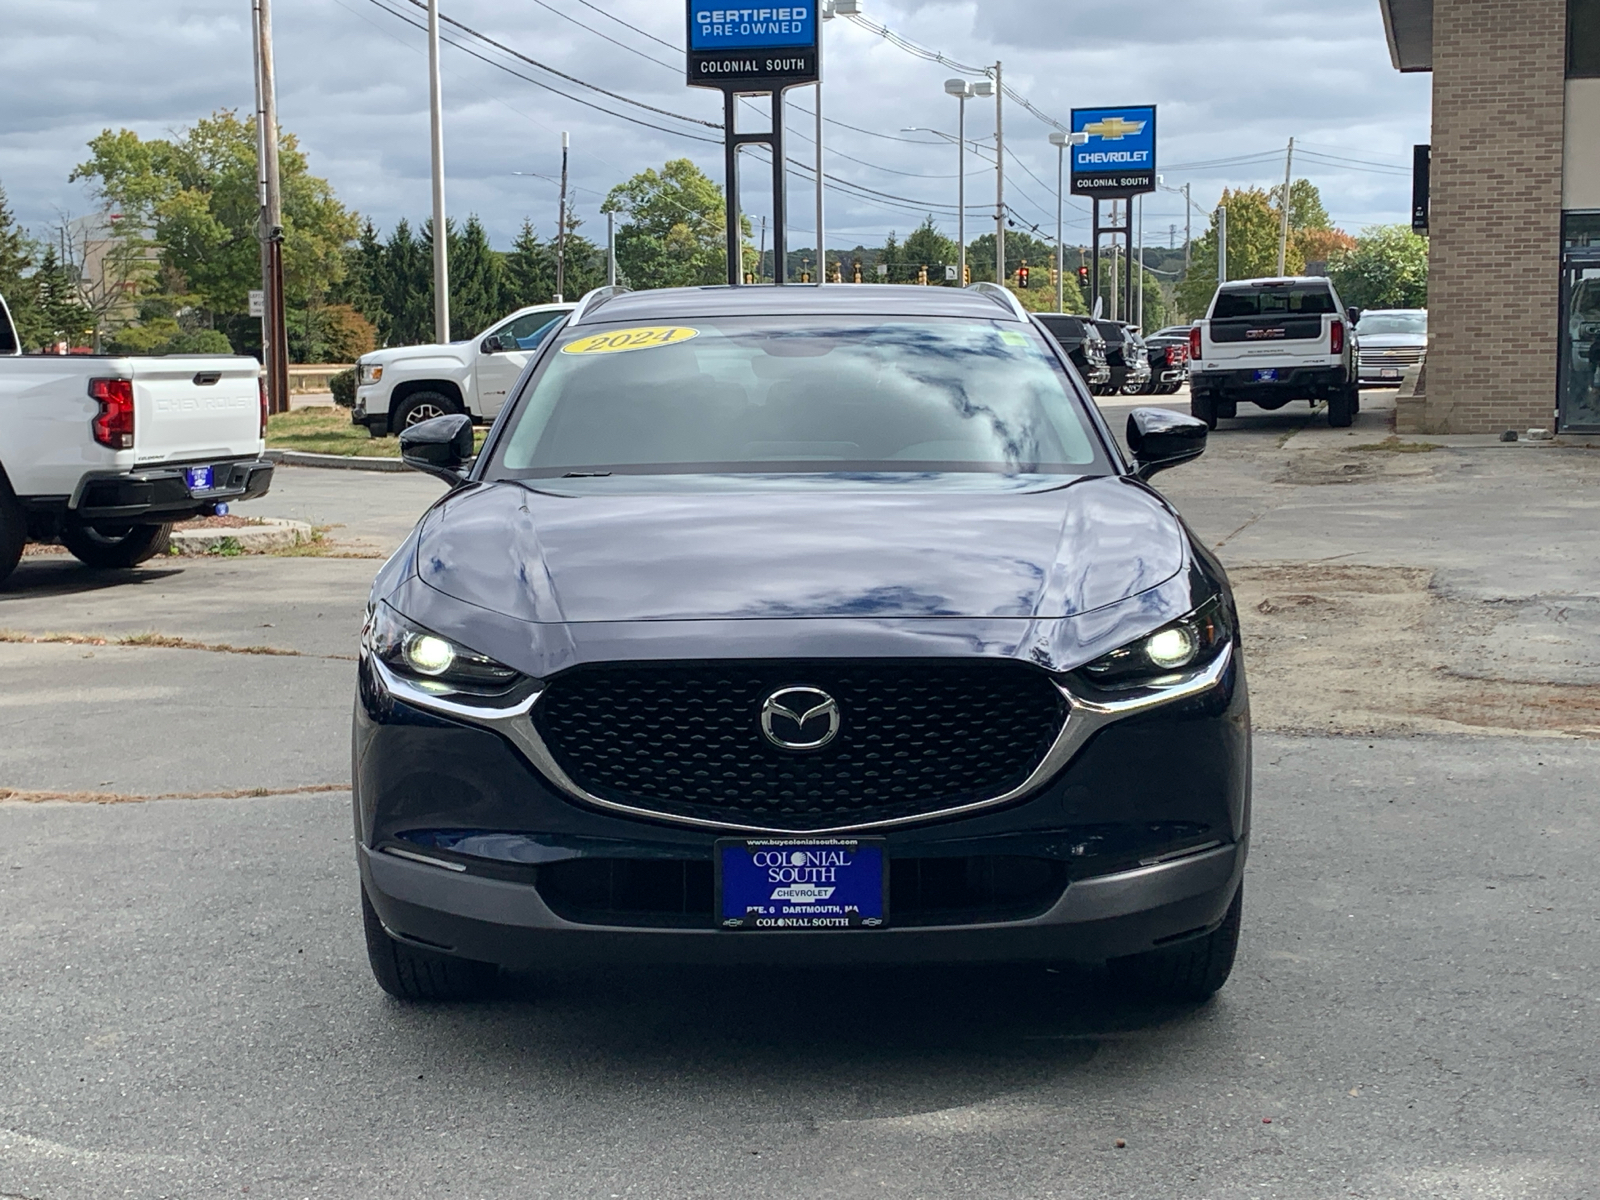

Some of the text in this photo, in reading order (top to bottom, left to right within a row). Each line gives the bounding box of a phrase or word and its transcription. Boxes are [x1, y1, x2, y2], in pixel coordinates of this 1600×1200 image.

[696, 7, 807, 24] CERTIFIED
[702, 21, 802, 37] PRE-OWNED
[700, 59, 805, 73] COLONIAL SOUTH
[1078, 150, 1149, 164] CHEVROLET
[1077, 177, 1149, 188] COLONIAL SOUTH
[584, 328, 678, 352] 2024
[1245, 328, 1285, 339] GMC
[155, 395, 254, 412] CHEVROLET
[747, 838, 858, 846] www.buycolonialsouth.com
[753, 851, 852, 867] COLONIAL
[768, 867, 836, 882] SOUTH
[777, 889, 829, 897] CHEVROLET
[769, 905, 775, 914] 6
[782, 905, 842, 914] DARTMOUTH,
[756, 918, 849, 927] COLONIAL SOUTH
